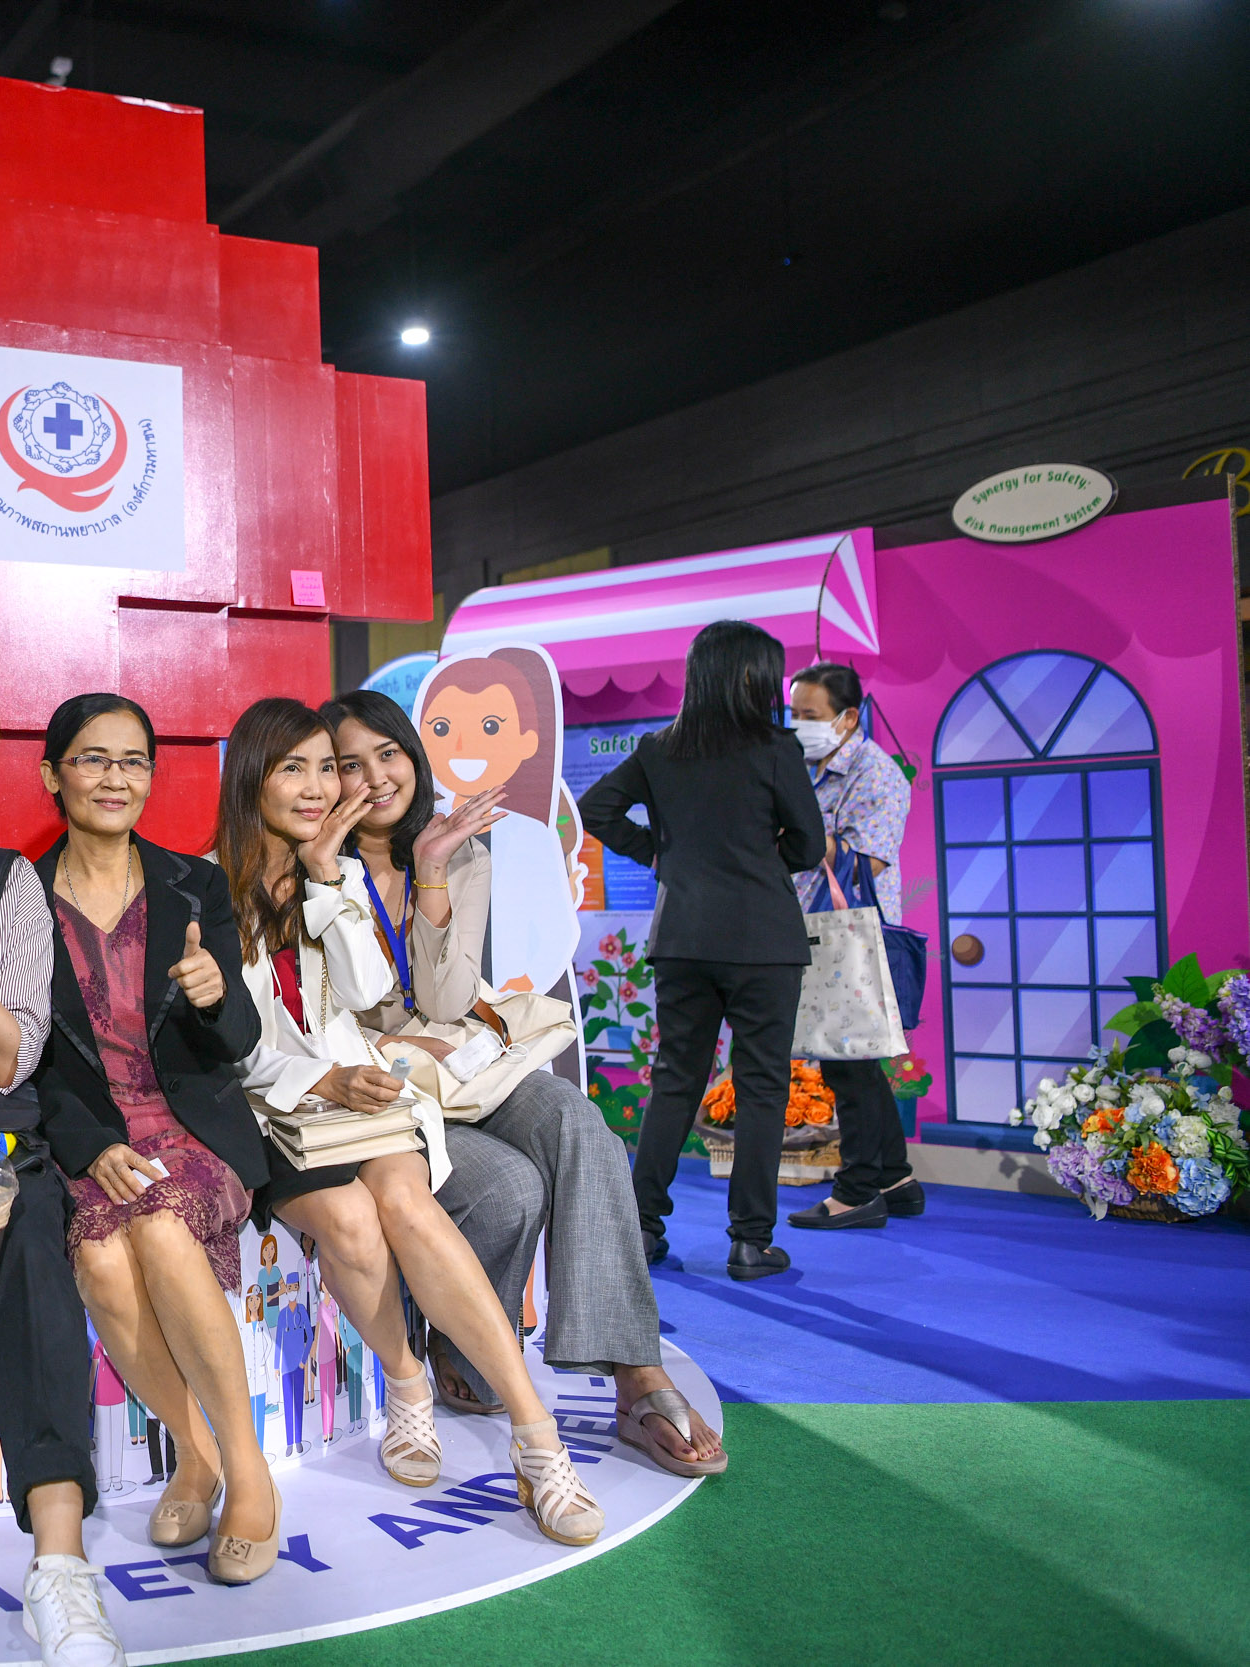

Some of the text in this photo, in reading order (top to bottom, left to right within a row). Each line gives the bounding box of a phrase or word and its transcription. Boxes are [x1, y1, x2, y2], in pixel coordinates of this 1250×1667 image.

[972, 477, 1019, 504] Synergy
[1023, 472, 1043, 485] for
[963, 496, 1102, 537] Risk Management System
[591, 734, 640, 754] Safet
[368, 1472, 525, 1550] AND
